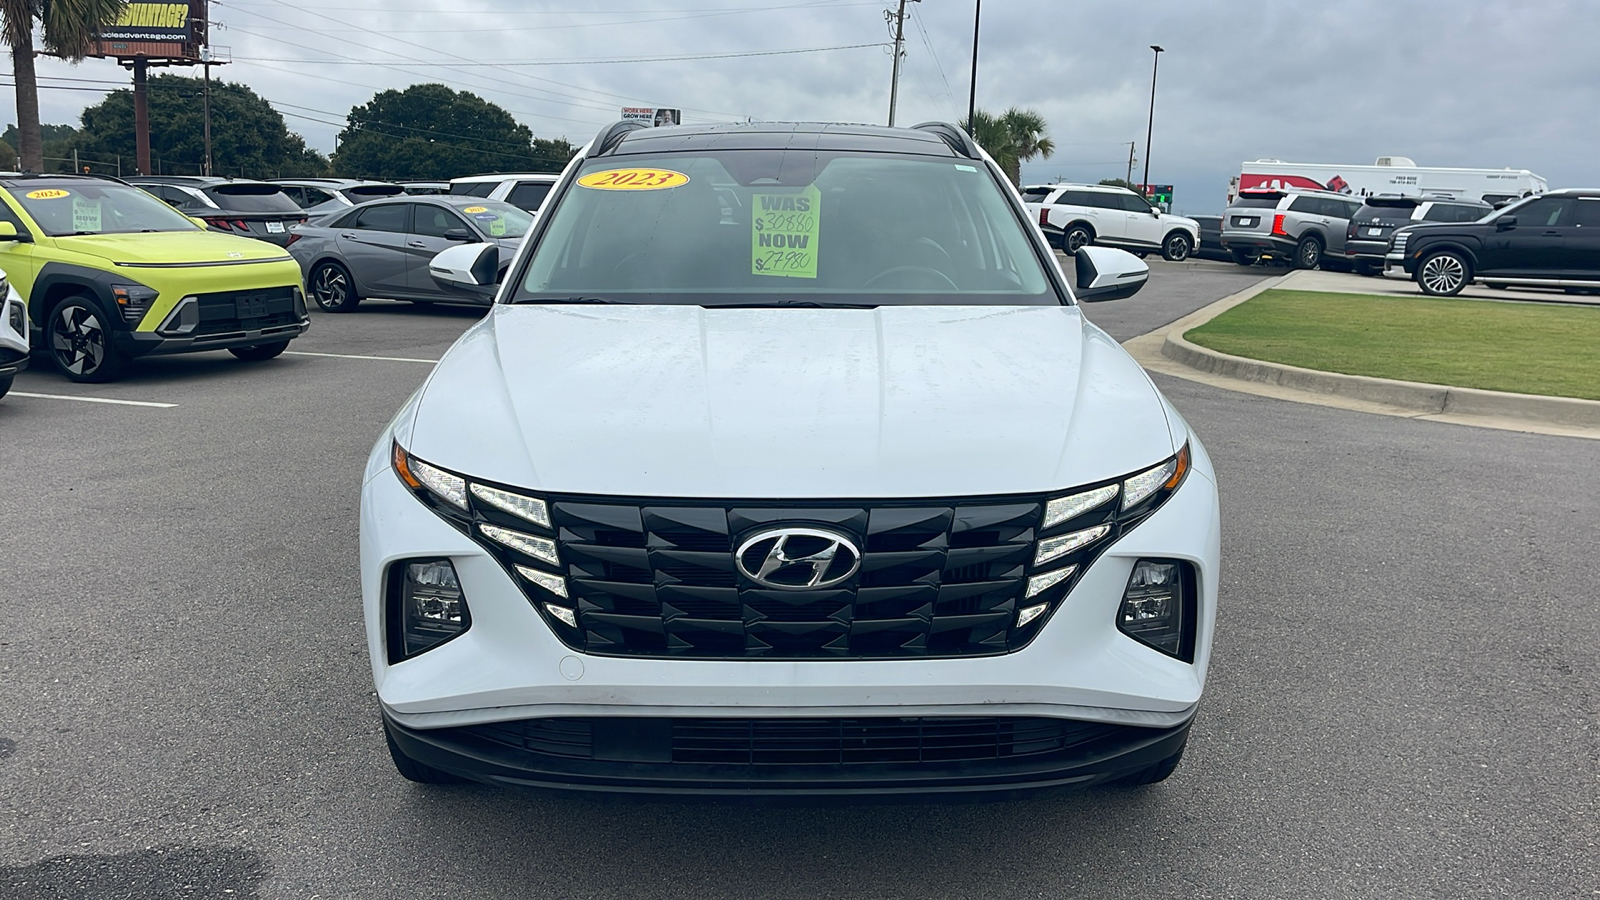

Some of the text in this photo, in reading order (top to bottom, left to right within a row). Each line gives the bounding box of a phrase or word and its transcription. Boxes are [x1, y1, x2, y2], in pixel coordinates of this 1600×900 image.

[591, 172, 675, 186] 2023
[34, 190, 61, 199] 2024
[760, 196, 810, 212] WAS
[759, 233, 810, 249] NOW
